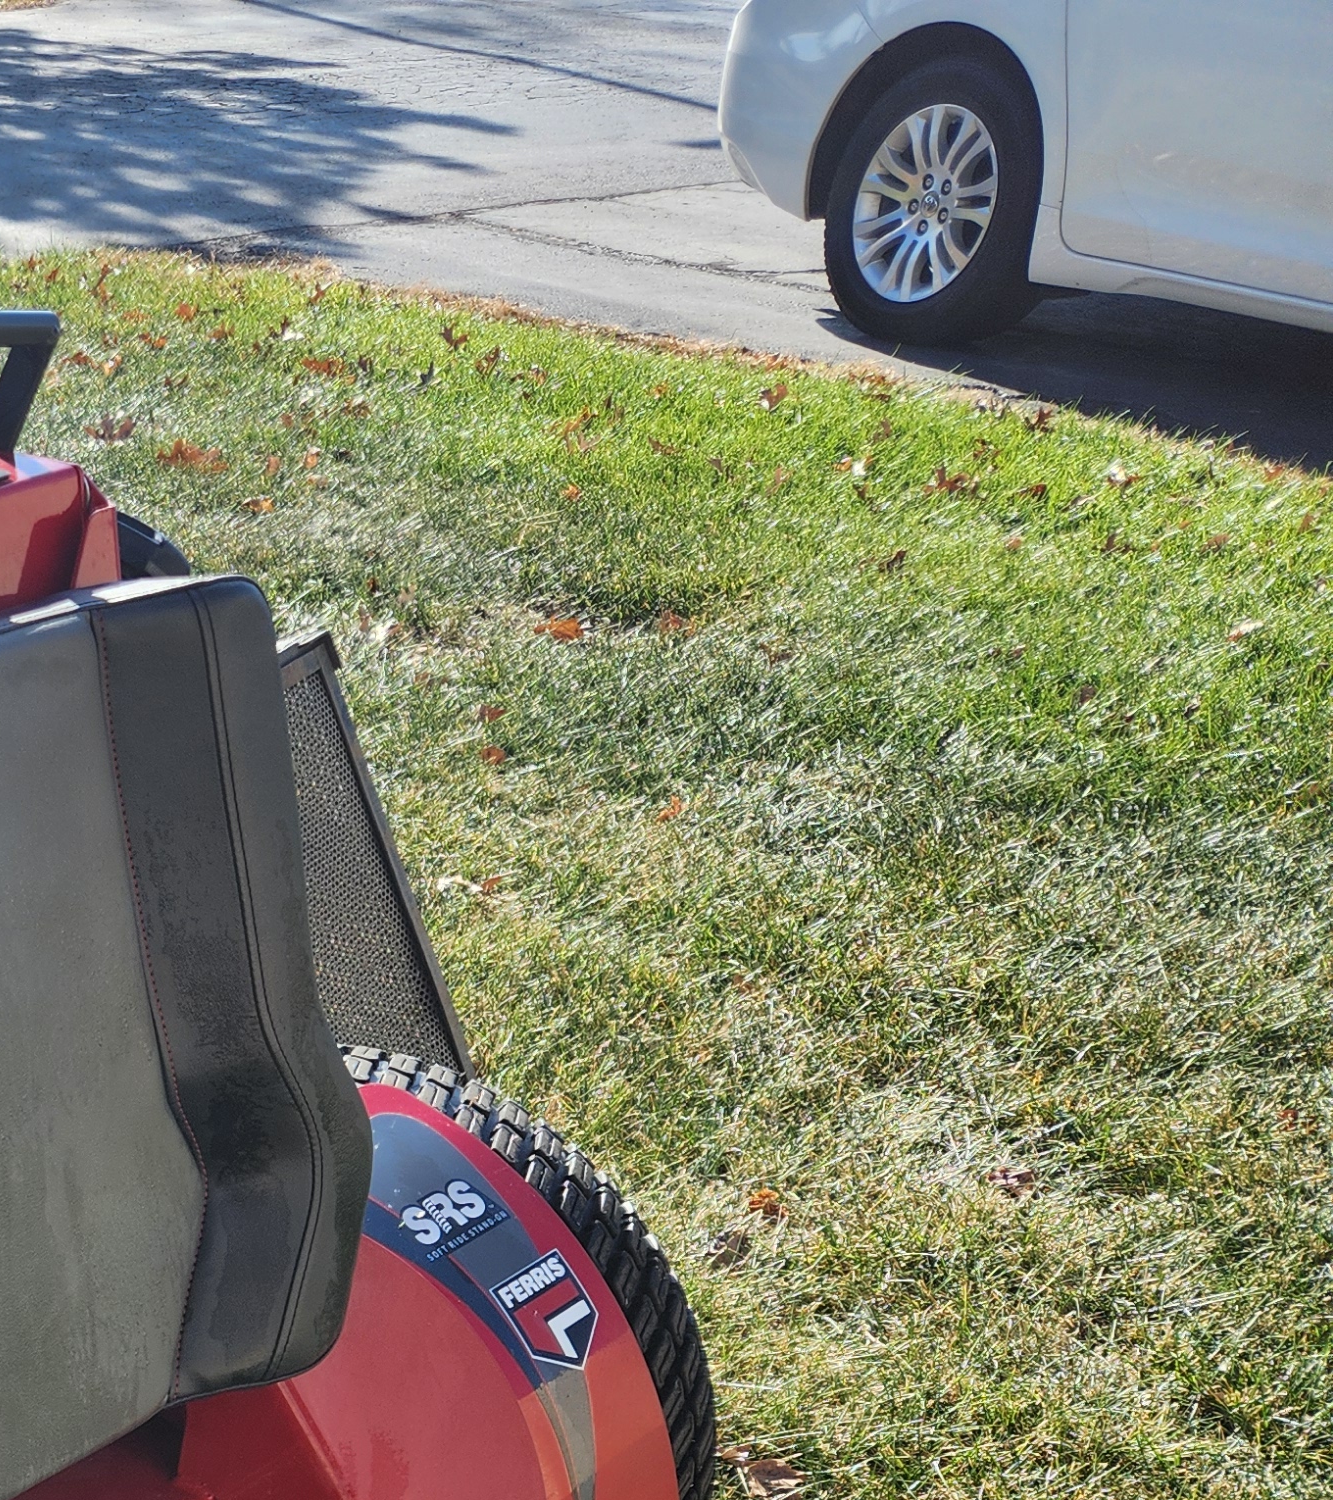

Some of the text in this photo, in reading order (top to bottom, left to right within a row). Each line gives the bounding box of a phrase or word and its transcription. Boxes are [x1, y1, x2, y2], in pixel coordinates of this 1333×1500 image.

[402, 1181, 485, 1244] SRS
[427, 1210, 507, 1261] SOFT RIDE STAND-ON
[498, 1258, 565, 1308] FERRIS
